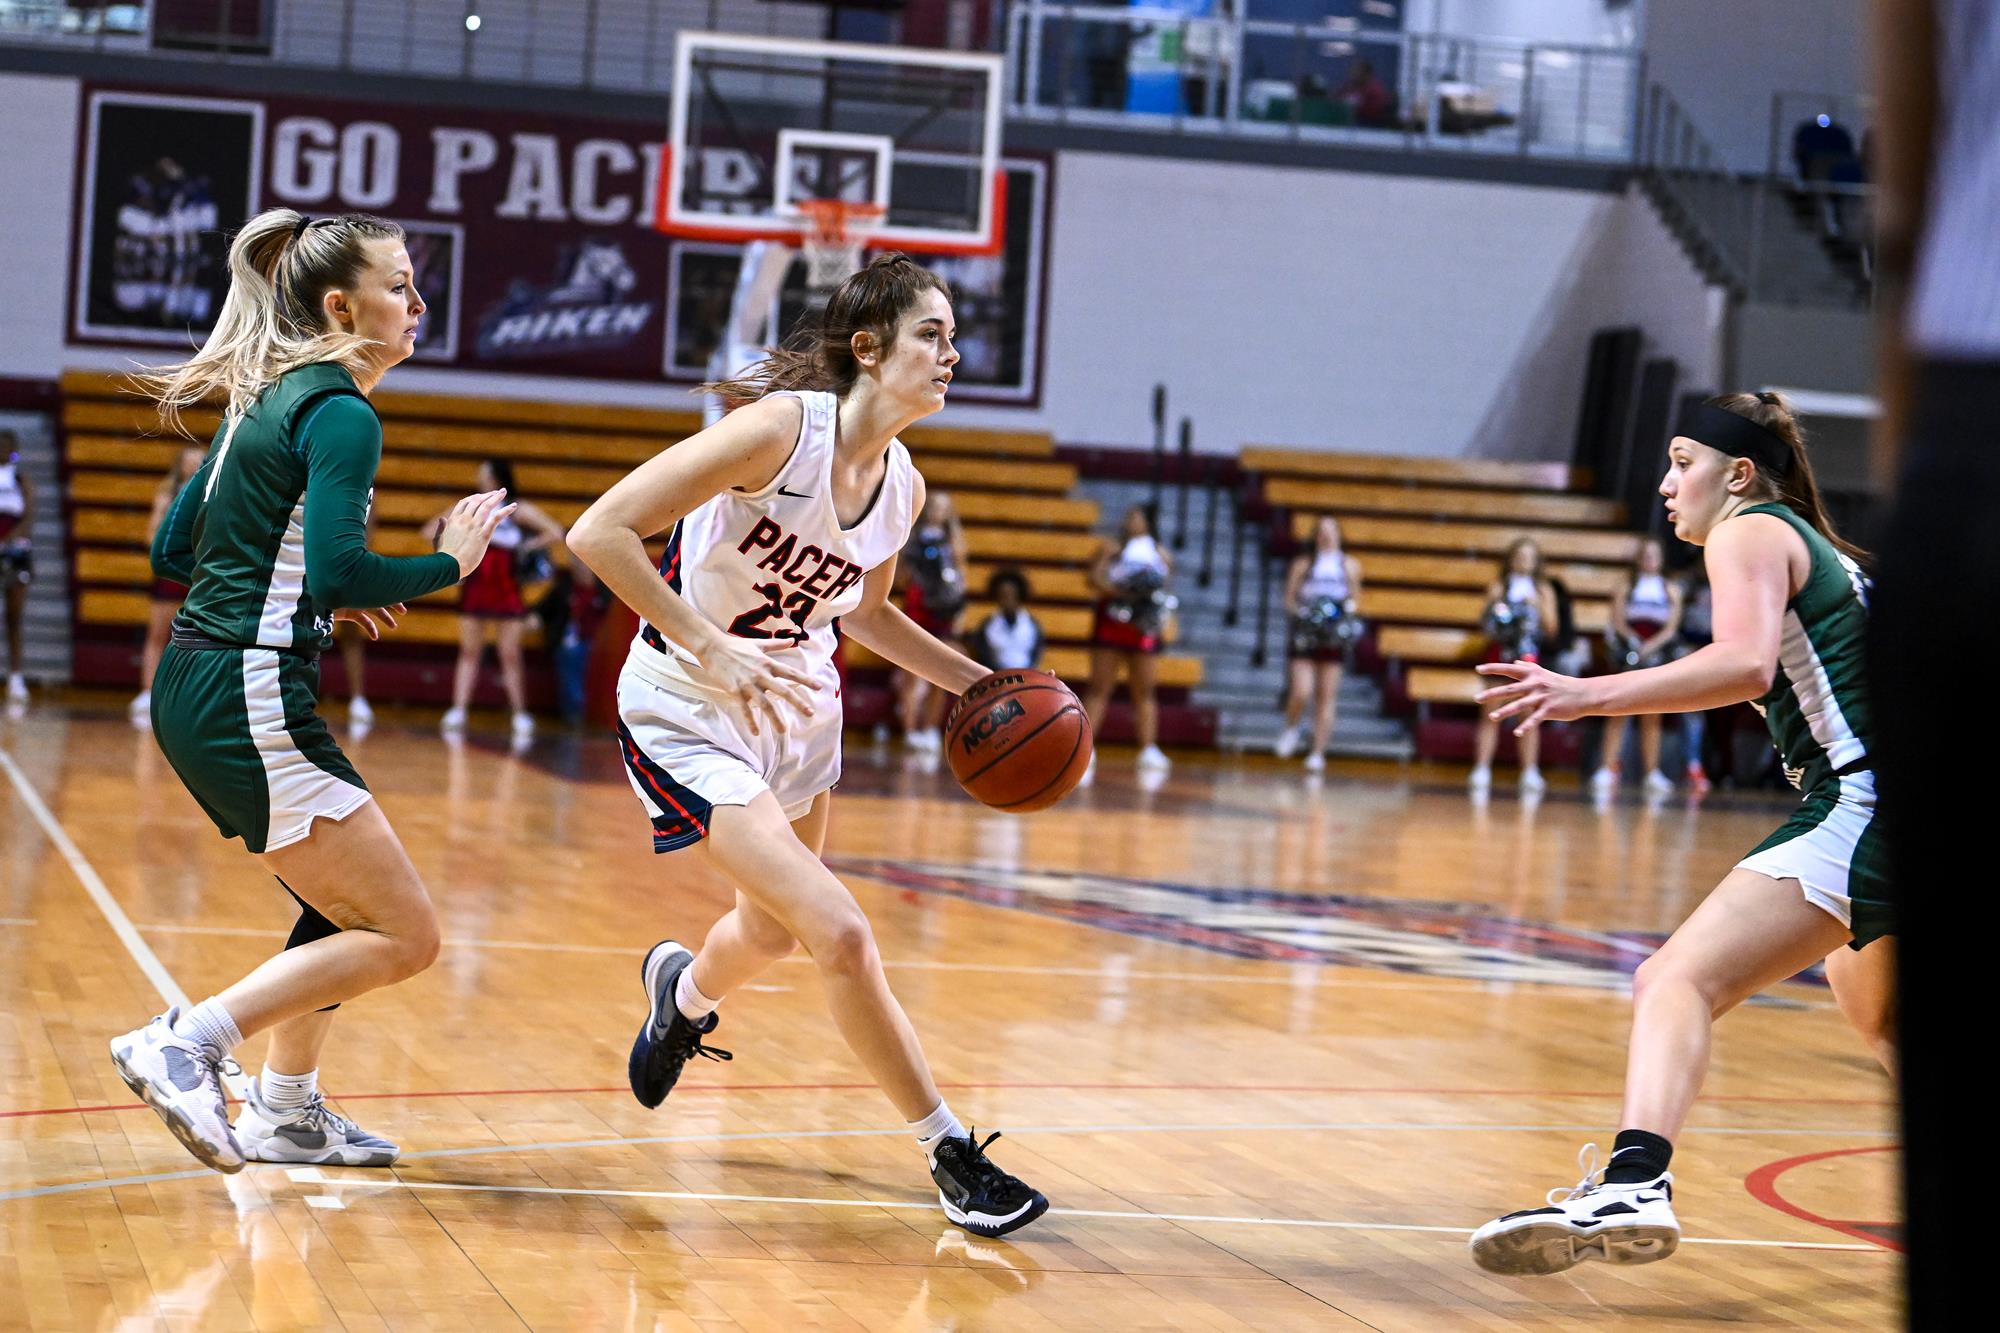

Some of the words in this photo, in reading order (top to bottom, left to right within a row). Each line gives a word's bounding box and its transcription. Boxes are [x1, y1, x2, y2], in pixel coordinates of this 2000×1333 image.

[270, 115, 400, 208] GO
[491, 303, 651, 346] AIKEN
[737, 515, 871, 601] PACER
[961, 698, 1026, 755] NCAA
